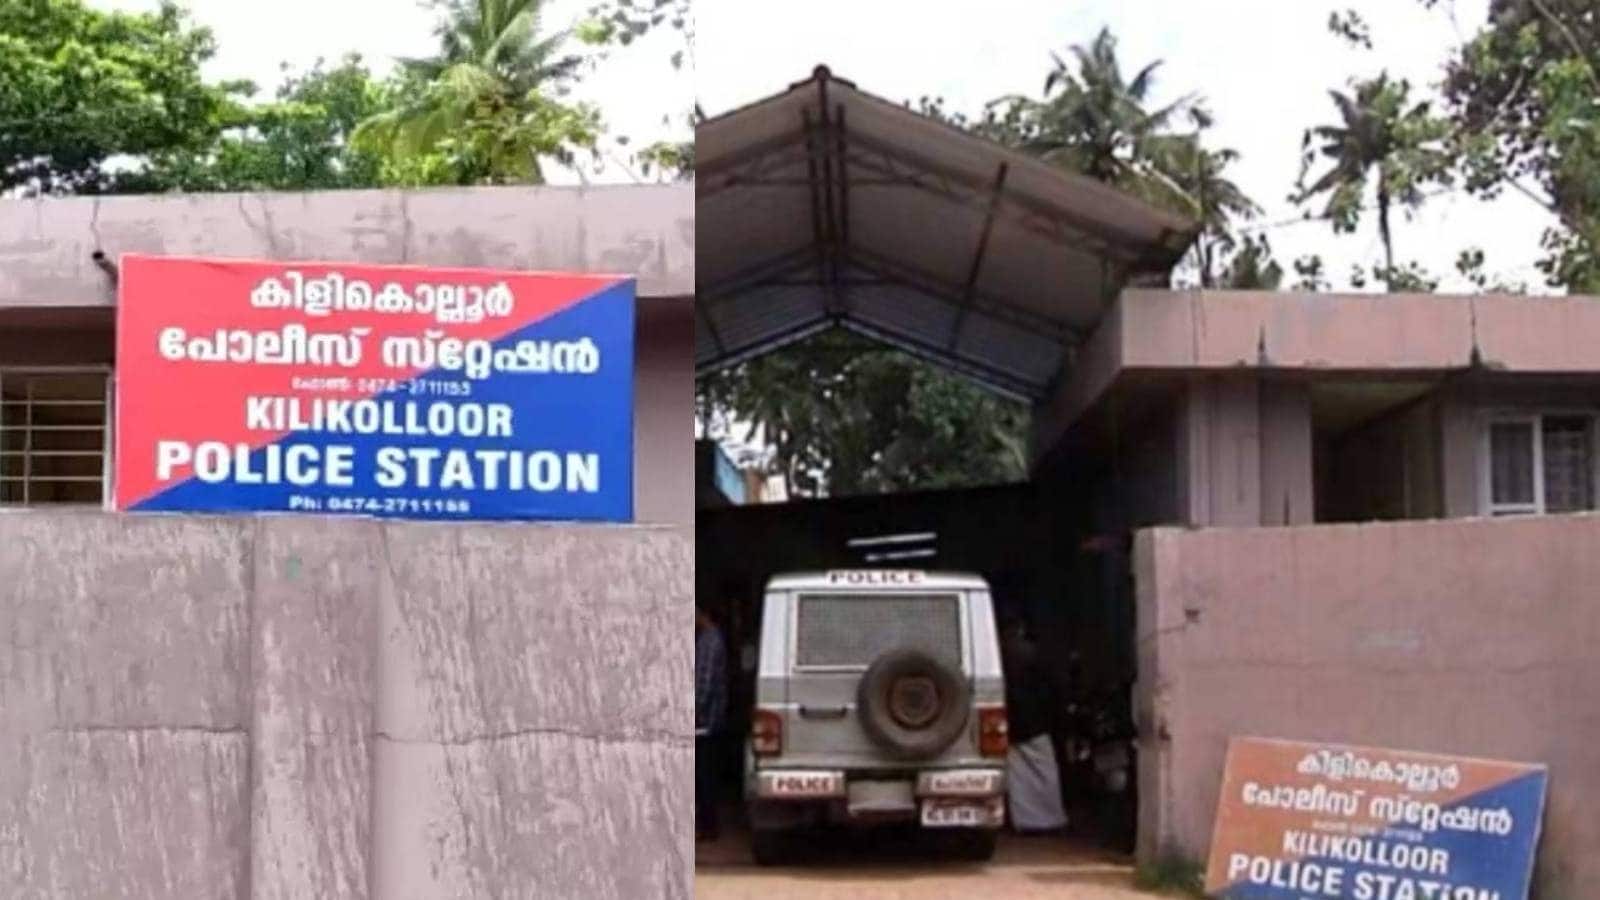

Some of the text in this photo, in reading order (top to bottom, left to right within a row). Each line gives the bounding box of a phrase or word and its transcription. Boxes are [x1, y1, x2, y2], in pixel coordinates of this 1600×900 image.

[158, 323, 371, 367] പോലീസ്
[246, 397, 513, 437] KILIKOLLOOR
[156, 441, 600, 492] POLICE STATION
[829, 571, 922, 584] POLICE
[777, 776, 829, 792] POLICE
[1283, 830, 1449, 875] KILIKOLLOOR
[1228, 854, 1343, 895] POLICE
